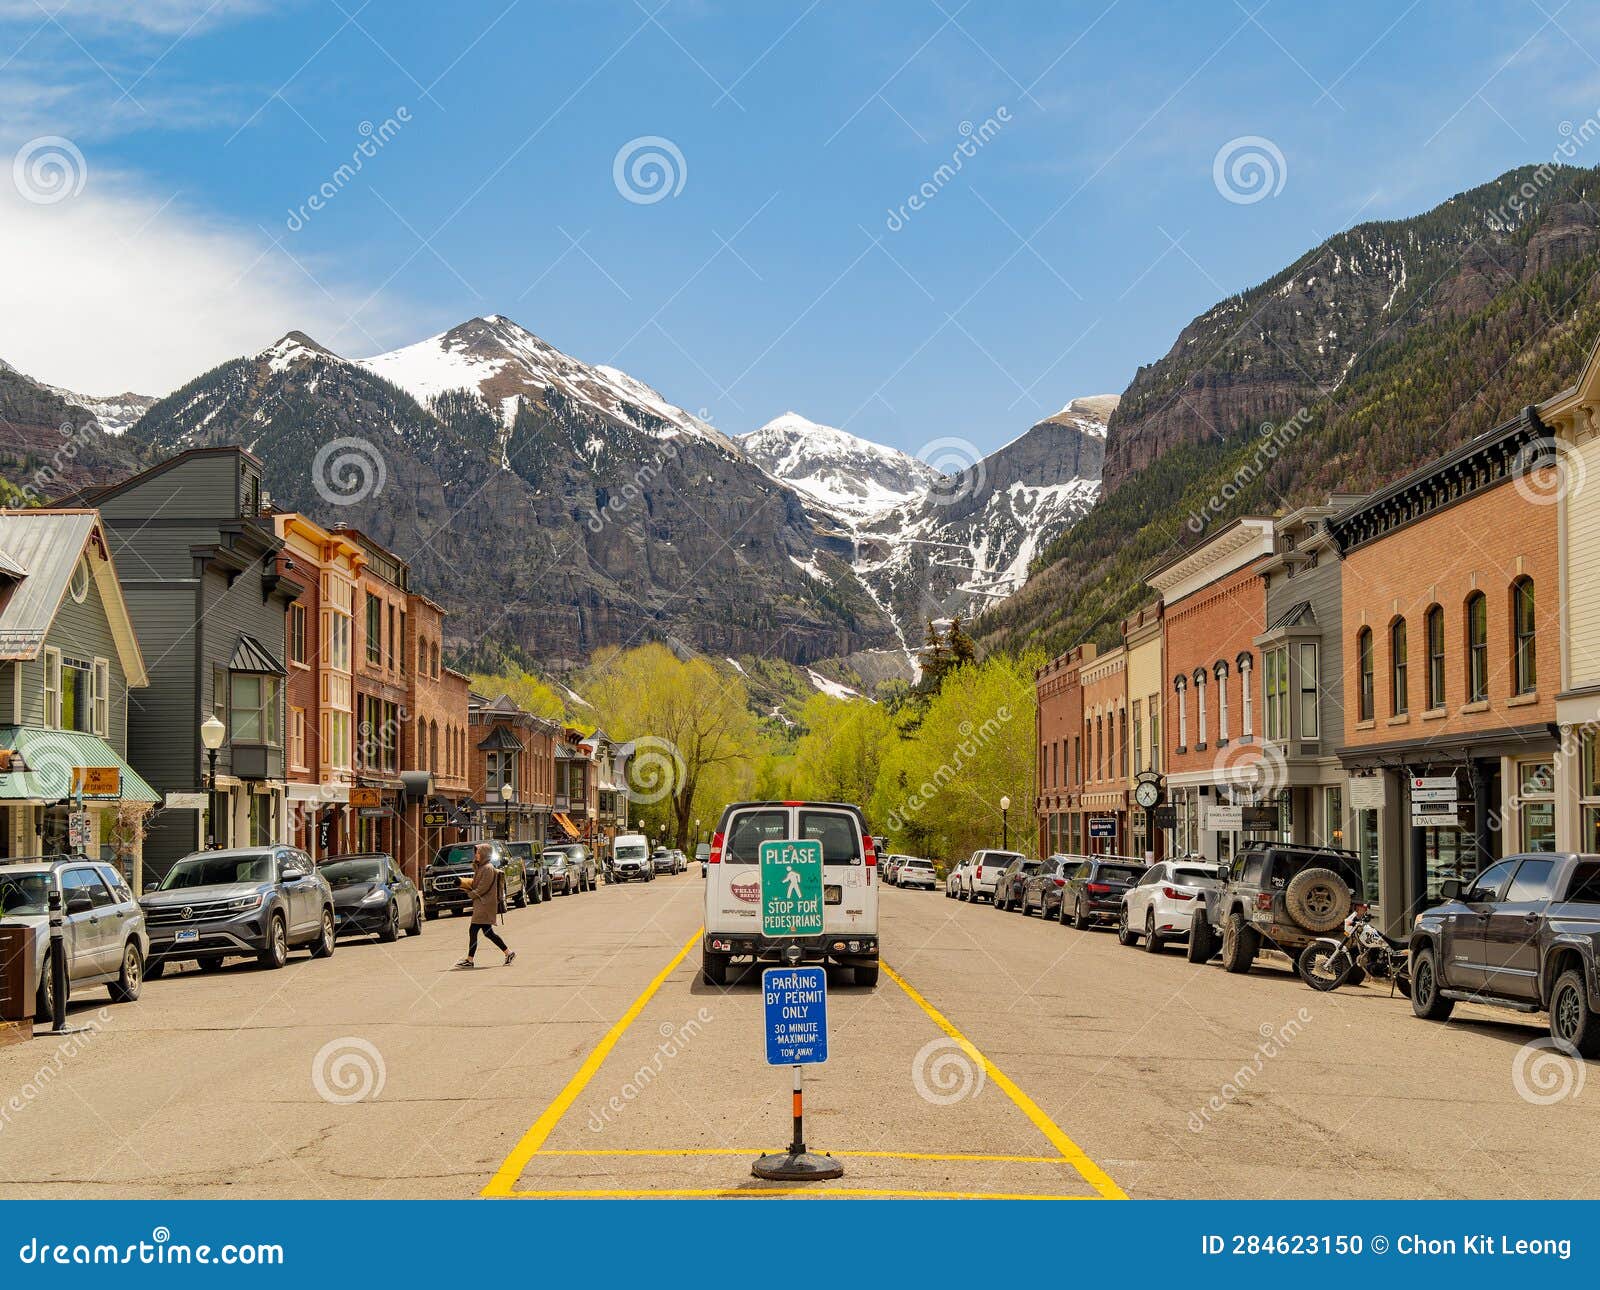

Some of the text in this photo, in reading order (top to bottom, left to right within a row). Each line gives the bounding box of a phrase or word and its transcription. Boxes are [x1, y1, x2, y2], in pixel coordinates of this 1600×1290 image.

[766, 848, 816, 865] PLEASE
[768, 900, 817, 914] STOP FOR
[764, 915, 822, 928] PEDESTRIANS
[772, 976, 817, 990] PARKING
[767, 990, 823, 1005] BY PERMIT
[782, 1006, 808, 1019] ONLY
[774, 1022, 818, 1034] 30 MINUTE
[781, 1048, 814, 1057] TOW AWAY
